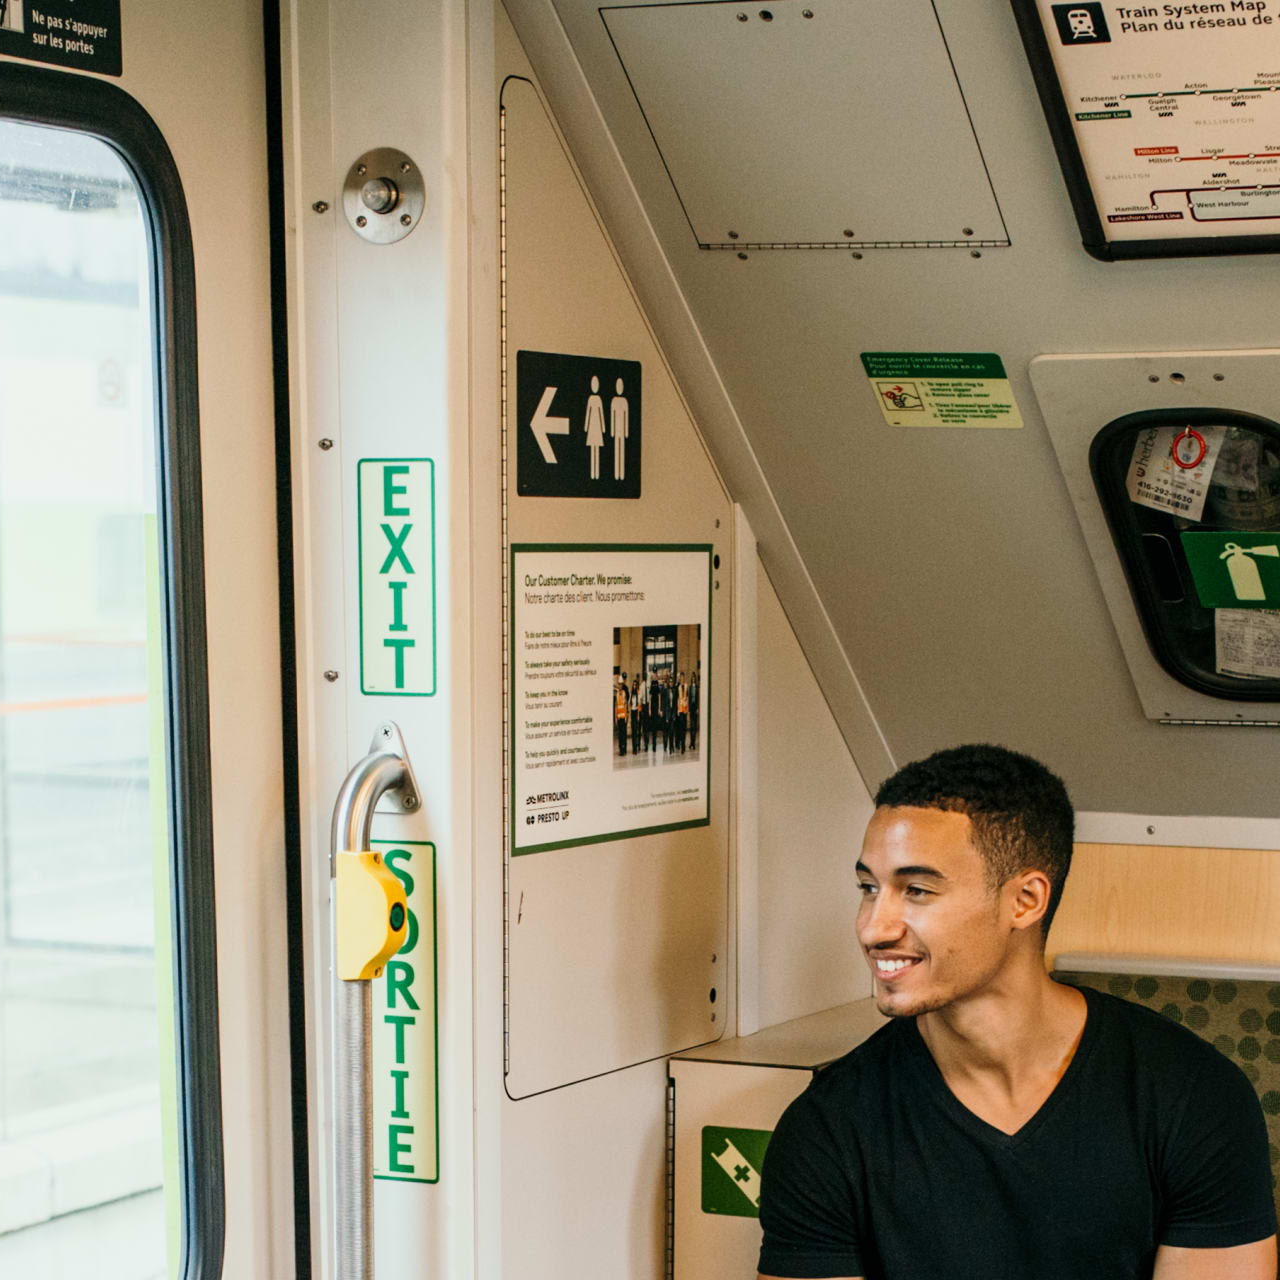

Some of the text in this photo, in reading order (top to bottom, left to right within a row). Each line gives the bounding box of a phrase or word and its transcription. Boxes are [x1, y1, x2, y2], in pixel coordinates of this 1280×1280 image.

[1117, 0, 1266, 19] Train System Map
[32, 10, 107, 38] Ne pas s'appuyer
[1121, 20, 1158, 33] Plan
[1164, 17, 1184, 31] du
[1191, 15, 1247, 29] réseau
[1253, 12, 1273, 25] de
[33, 32, 94, 55] sur les portes
[1080, 95, 1118, 103] Kitchener
[1148, 98, 1176, 106] Guelph
[1212, 93, 1261, 102] Georgetown
[1078, 112, 1112, 120] Kitchener
[379, 466, 415, 689] EXIT
[525, 573, 632, 587] Our Customer Charter. We promise:
[525, 593, 543, 604] Notre
[544, 592, 563, 604] charte
[564, 591, 575, 603] des
[595, 590, 611, 602] Nous
[537, 791, 569, 803] METROLINX
[537, 811, 570, 824] PRESTO UP
